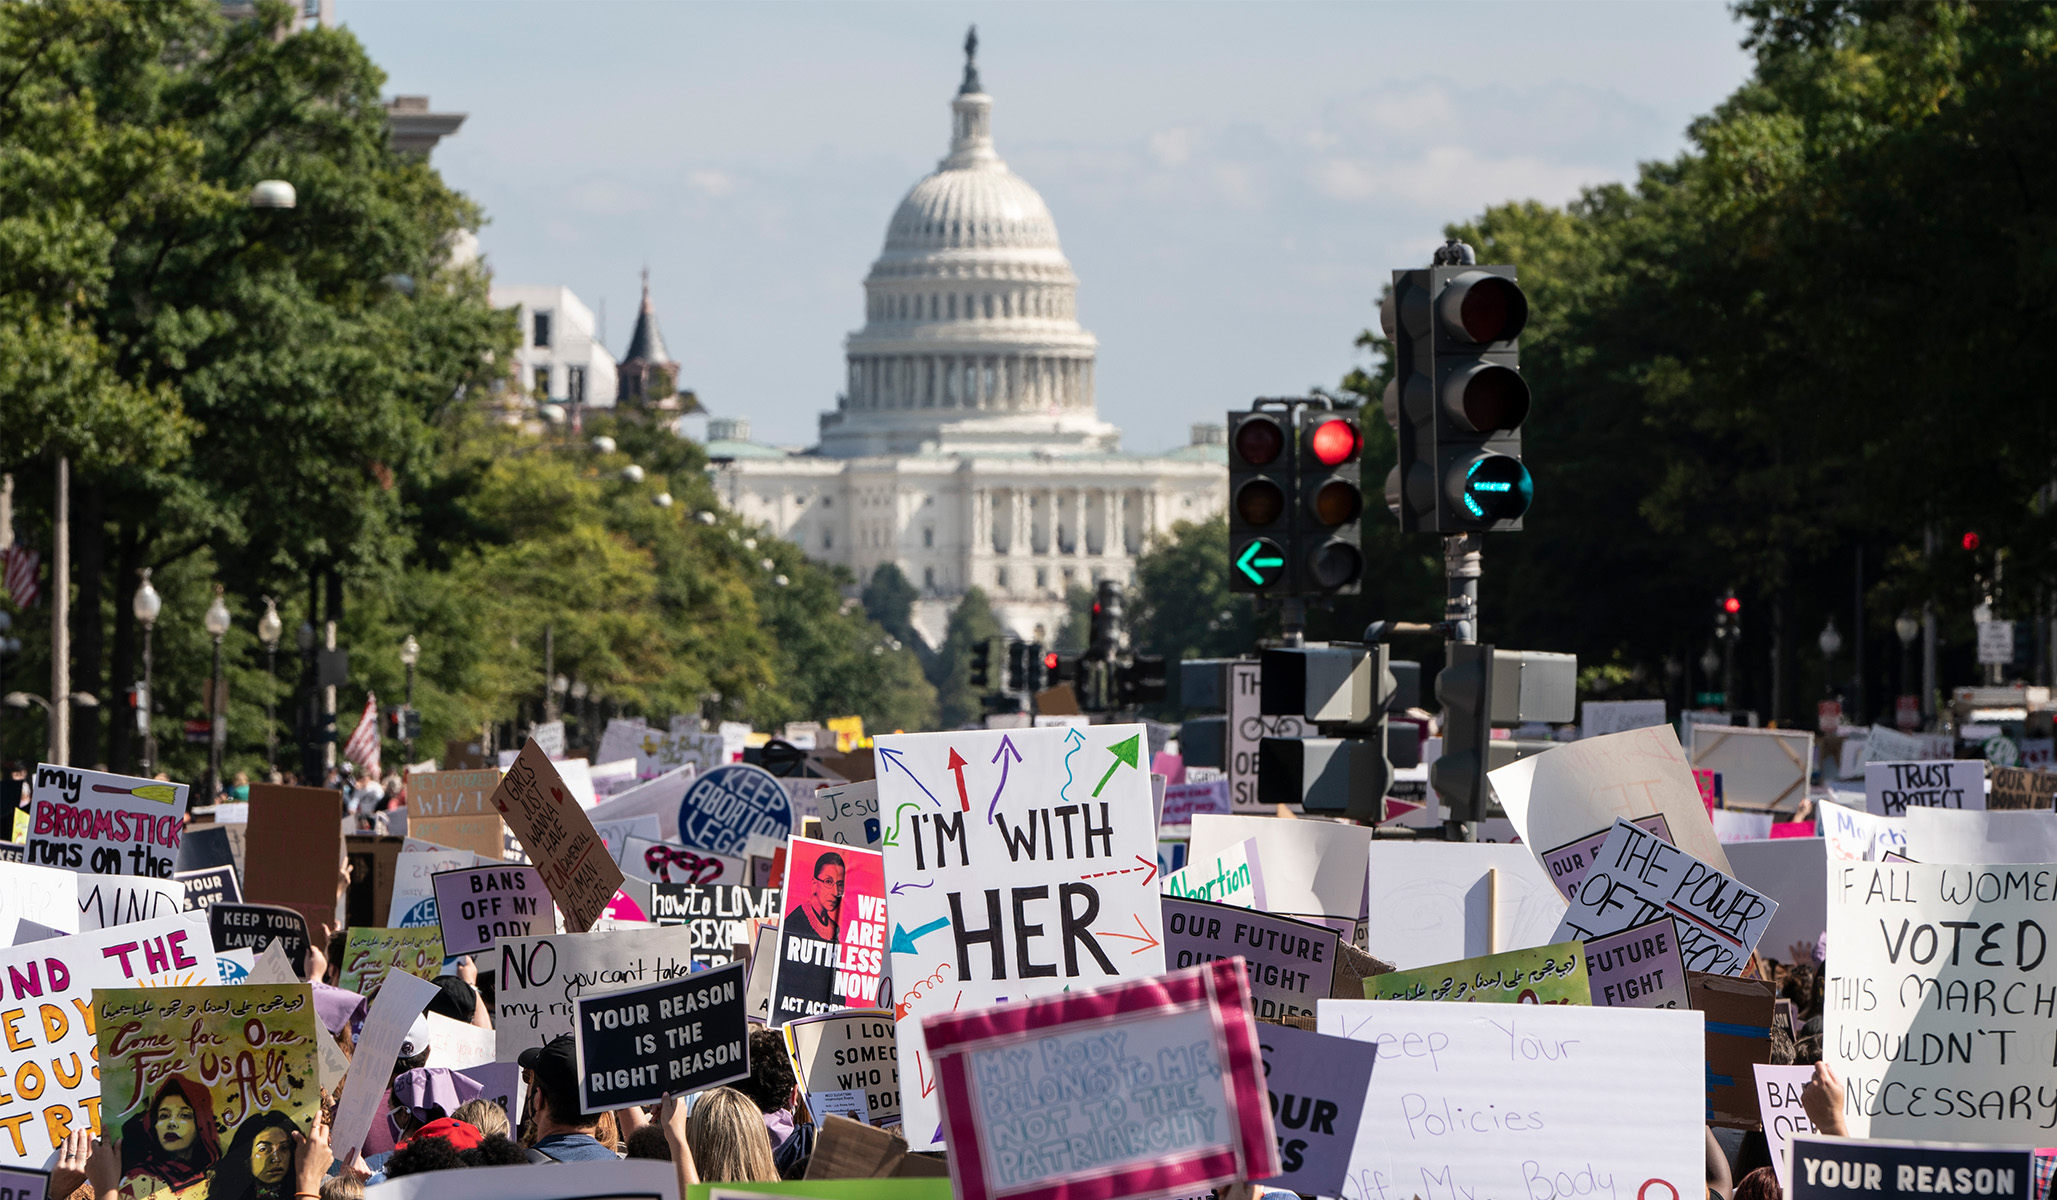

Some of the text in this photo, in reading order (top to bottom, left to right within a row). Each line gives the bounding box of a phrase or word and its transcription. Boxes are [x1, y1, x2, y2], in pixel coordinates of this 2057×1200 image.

[38, 768, 82, 803] my
[504, 757, 535, 801] GIRLS
[722, 769, 785, 812] KEEP
[1888, 763, 1954, 790] TRUST
[417, 790, 486, 816] WHAT
[520, 780, 544, 821] JUST
[688, 779, 789, 841] ABORTION
[1882, 788, 1964, 816] PROTECT
[34, 801, 184, 849] BROOMSTICK
[526, 802, 560, 848] WANNA
[543, 818, 567, 858] HAVE
[911, 802, 1113, 870] I'M WITH
[28, 839, 174, 879] runs on the
[1169, 857, 1251, 901] Abortion
[1553, 852, 1584, 877] OUR
[185, 875, 222, 893] YOUR
[470, 872, 526, 893] BANS
[565, 857, 599, 907] HUMAN
[716, 885, 782, 919] LOWE
[1581, 872, 1639, 916] OF
[1615, 822, 1766, 948] THE POWER
[1838, 867, 1855, 905] IF
[1865, 868, 1917, 905] ALL
[223, 912, 301, 931] KEEP YOUR
[413, 900, 439, 920] KE
[461, 896, 537, 921] OFF MY
[577, 878, 610, 932] RIGHTS
[857, 894, 886, 924] WE
[225, 933, 267, 948] LAWS
[477, 922, 531, 944] BODY
[845, 920, 886, 949] ARE
[946, 882, 1120, 981] HER
[1170, 913, 1222, 940] OUR
[1234, 923, 1325, 964] FUTURE
[1879, 918, 2048, 971] VOTED
[0, 957, 70, 1000] ND
[101, 929, 198, 979] THE
[348, 950, 384, 974] Come
[502, 940, 557, 991] NO
[563, 970, 598, 1000] you
[1585, 933, 1668, 977] FUTURE
[590, 981, 736, 1031] YOUR REASON
[781, 996, 804, 1012] ACT
[834, 971, 880, 1001] NOW
[1604, 968, 1666, 1006] FIGHT
[1831, 973, 2057, 1018] THIS MARCH
[502, 1003, 543, 1029] my
[846, 1024, 851, 1039] I
[103, 1021, 176, 1059] Come
[180, 1018, 230, 1058] for
[243, 1017, 307, 1049] One,
[635, 1022, 703, 1055] IS THE
[974, 1029, 1128, 1084] MY BODY
[1490, 1018, 1581, 1061] Your
[592, 1040, 741, 1092] RIGHT REASON
[837, 1069, 881, 1090] WHO
[116, 1047, 290, 1128] Face Us All
[981, 1062, 1122, 1122] BELONGS
[1845, 1077, 2057, 1129] NECESSARY
[988, 1079, 1207, 1150] NOT TO THE
[1401, 1093, 1546, 1140] Policies
[995, 1105, 1218, 1185] PATRIARCHY
[1420, 1165, 1475, 1200] My
[1522, 1160, 1616, 1200] Body
[1803, 1157, 2016, 1196] YOUR REASON
